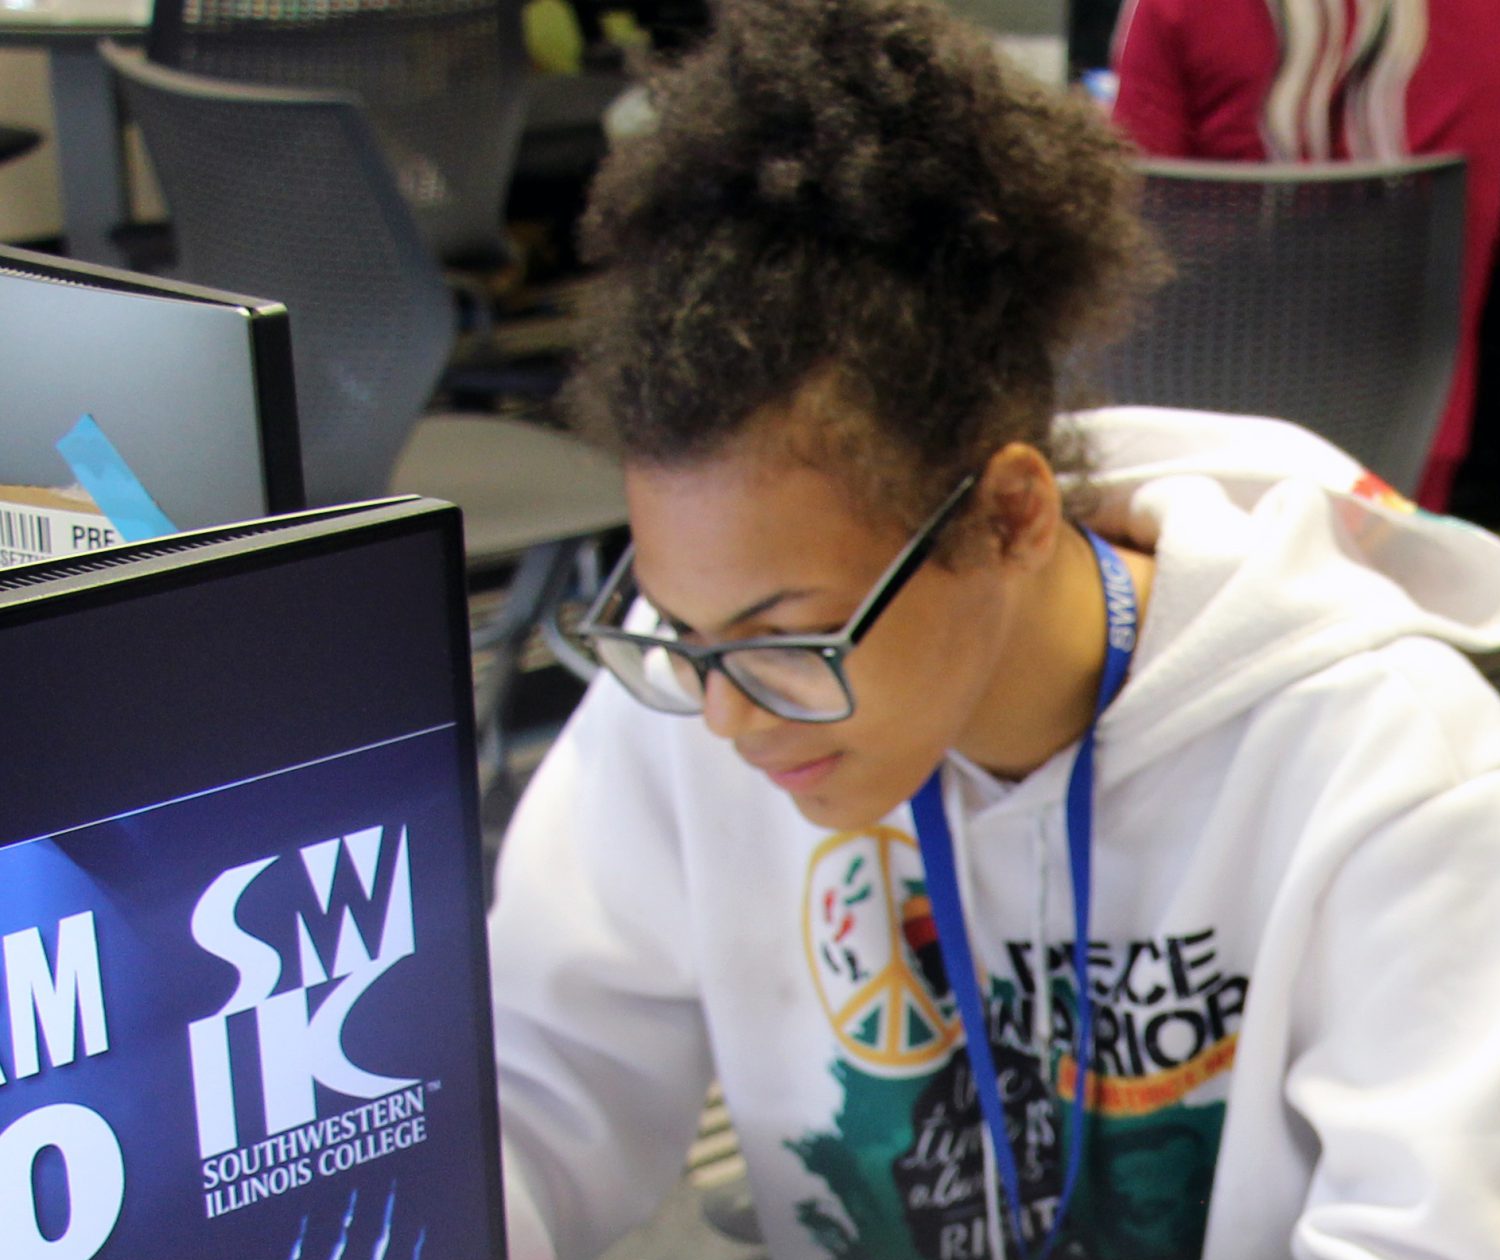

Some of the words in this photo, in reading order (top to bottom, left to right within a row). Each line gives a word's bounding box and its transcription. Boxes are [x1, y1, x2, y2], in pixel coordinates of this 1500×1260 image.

[0, 910, 110, 1086] M
[202, 1085, 426, 1190] SOUTHWESTERN
[205, 1158, 313, 1219] ILLINOIS
[318, 1116, 428, 1177] COLLEGE
